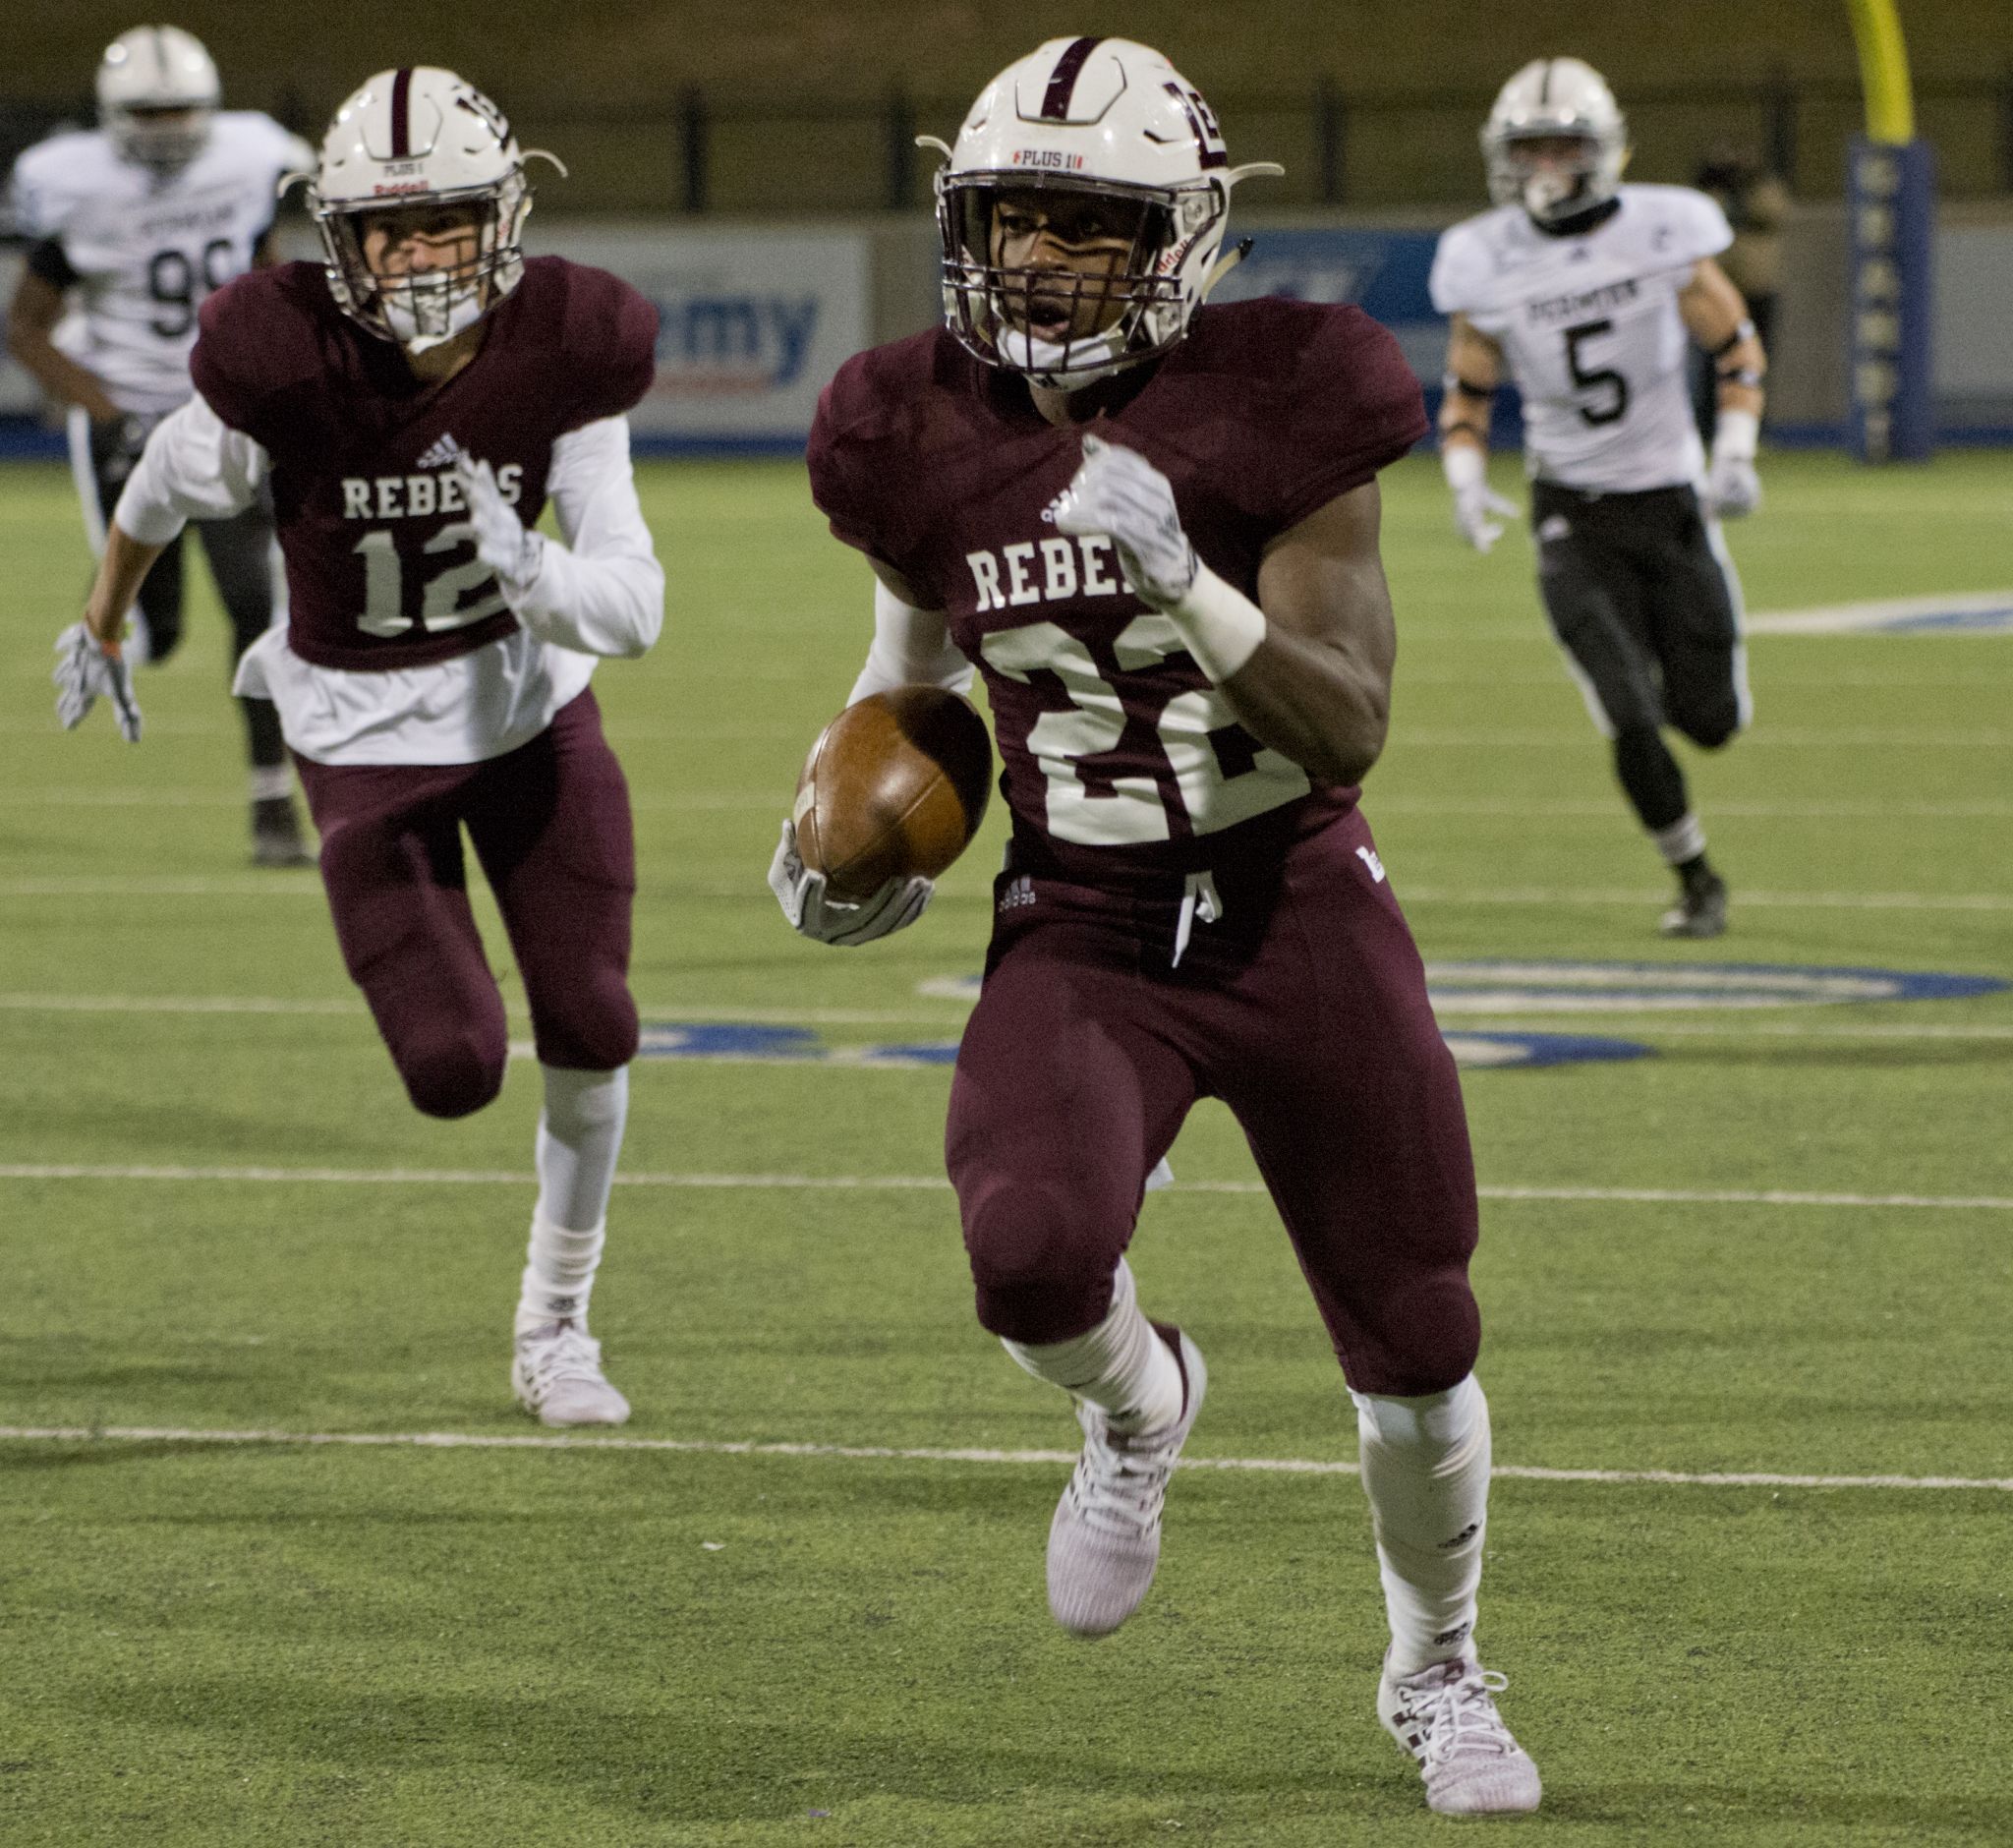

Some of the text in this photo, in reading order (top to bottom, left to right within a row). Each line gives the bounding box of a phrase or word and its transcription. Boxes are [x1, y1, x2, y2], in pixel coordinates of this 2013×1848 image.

[1022, 149, 1063, 167] PLUS
[1567, 318, 1628, 427] 5
[342, 462, 523, 520] REBES
[354, 521, 510, 638] 12
[966, 534, 1135, 612] REBE
[982, 613, 1312, 846] 22
